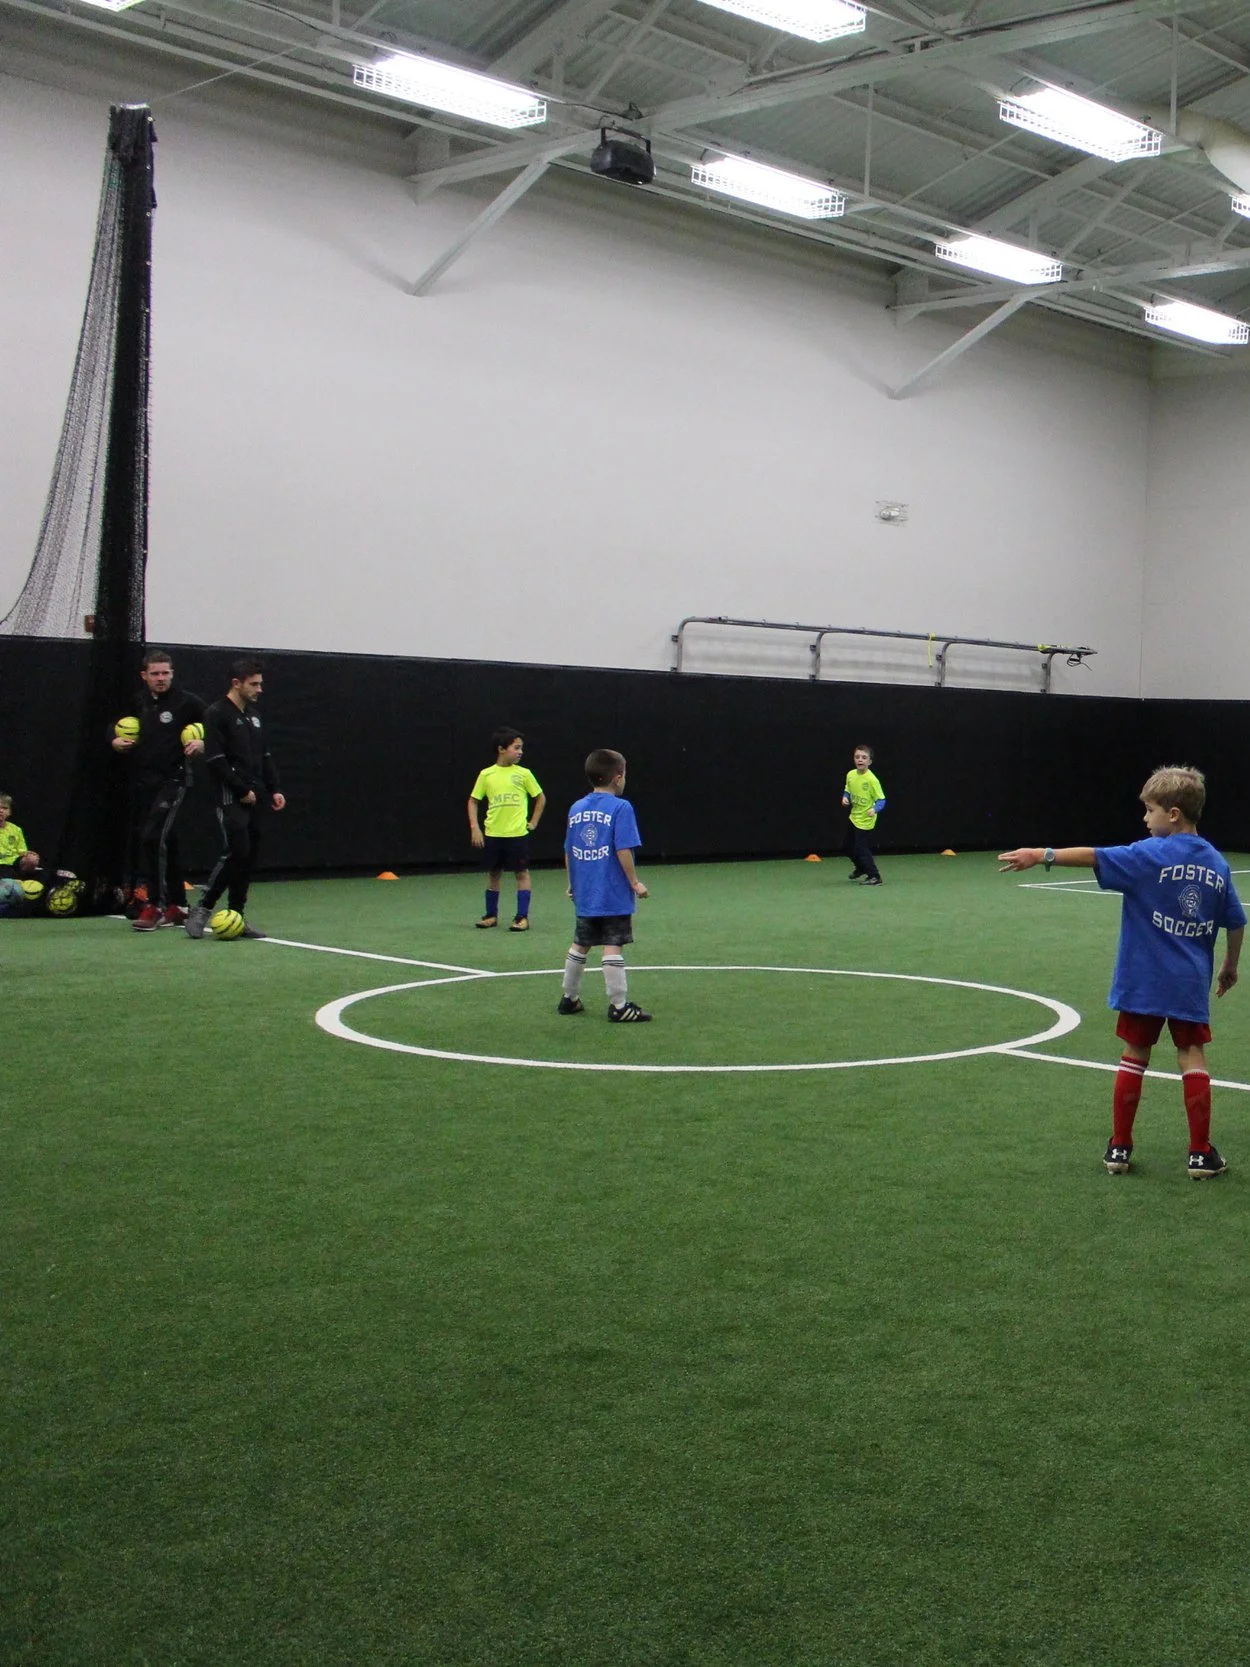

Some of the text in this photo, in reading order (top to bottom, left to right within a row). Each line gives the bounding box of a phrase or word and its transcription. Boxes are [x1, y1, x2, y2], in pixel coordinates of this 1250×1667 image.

[493, 793, 521, 803] MFC
[568, 810, 612, 828] FOSTER
[572, 845, 609, 861] SOCCER
[1158, 864, 1224, 893] FOSTER
[1152, 910, 1214, 937] SOCCER
